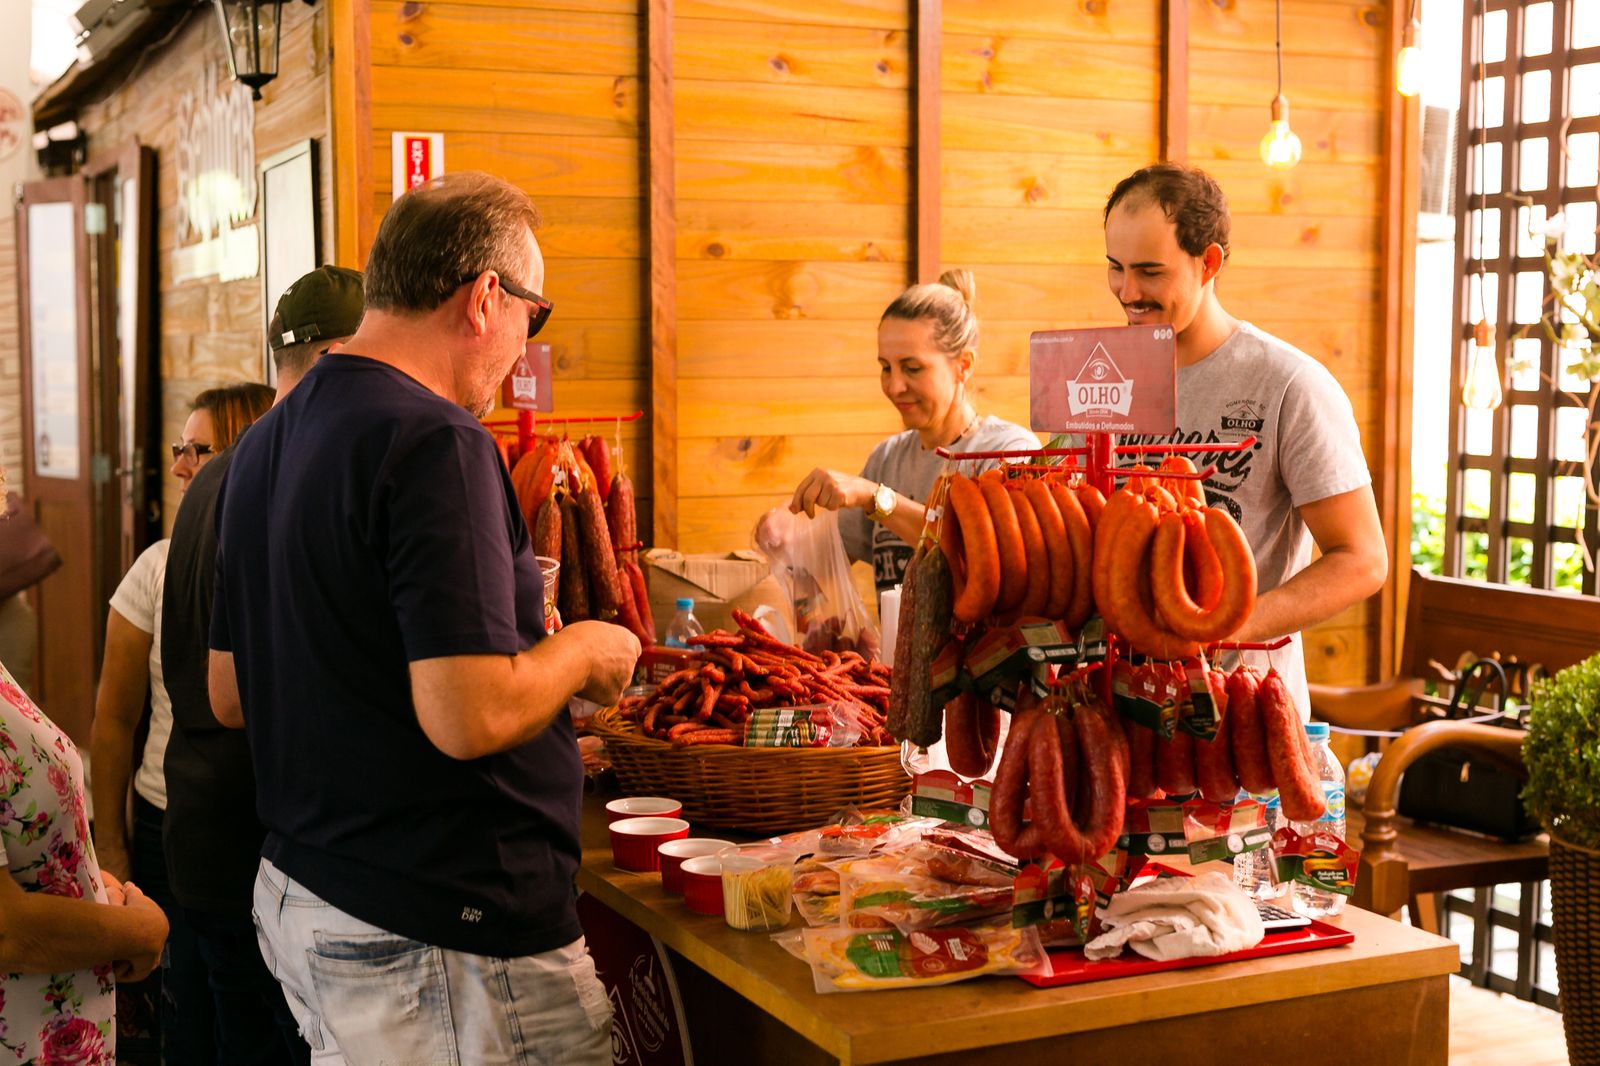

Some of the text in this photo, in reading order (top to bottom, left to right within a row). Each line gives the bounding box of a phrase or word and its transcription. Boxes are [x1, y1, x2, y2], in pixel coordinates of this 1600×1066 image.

[1078, 386, 1120, 405] OLHO
[1065, 421, 1096, 430] Embutidos
[1227, 419, 1256, 429] OLHO
[461, 911, 482, 923] DRY
